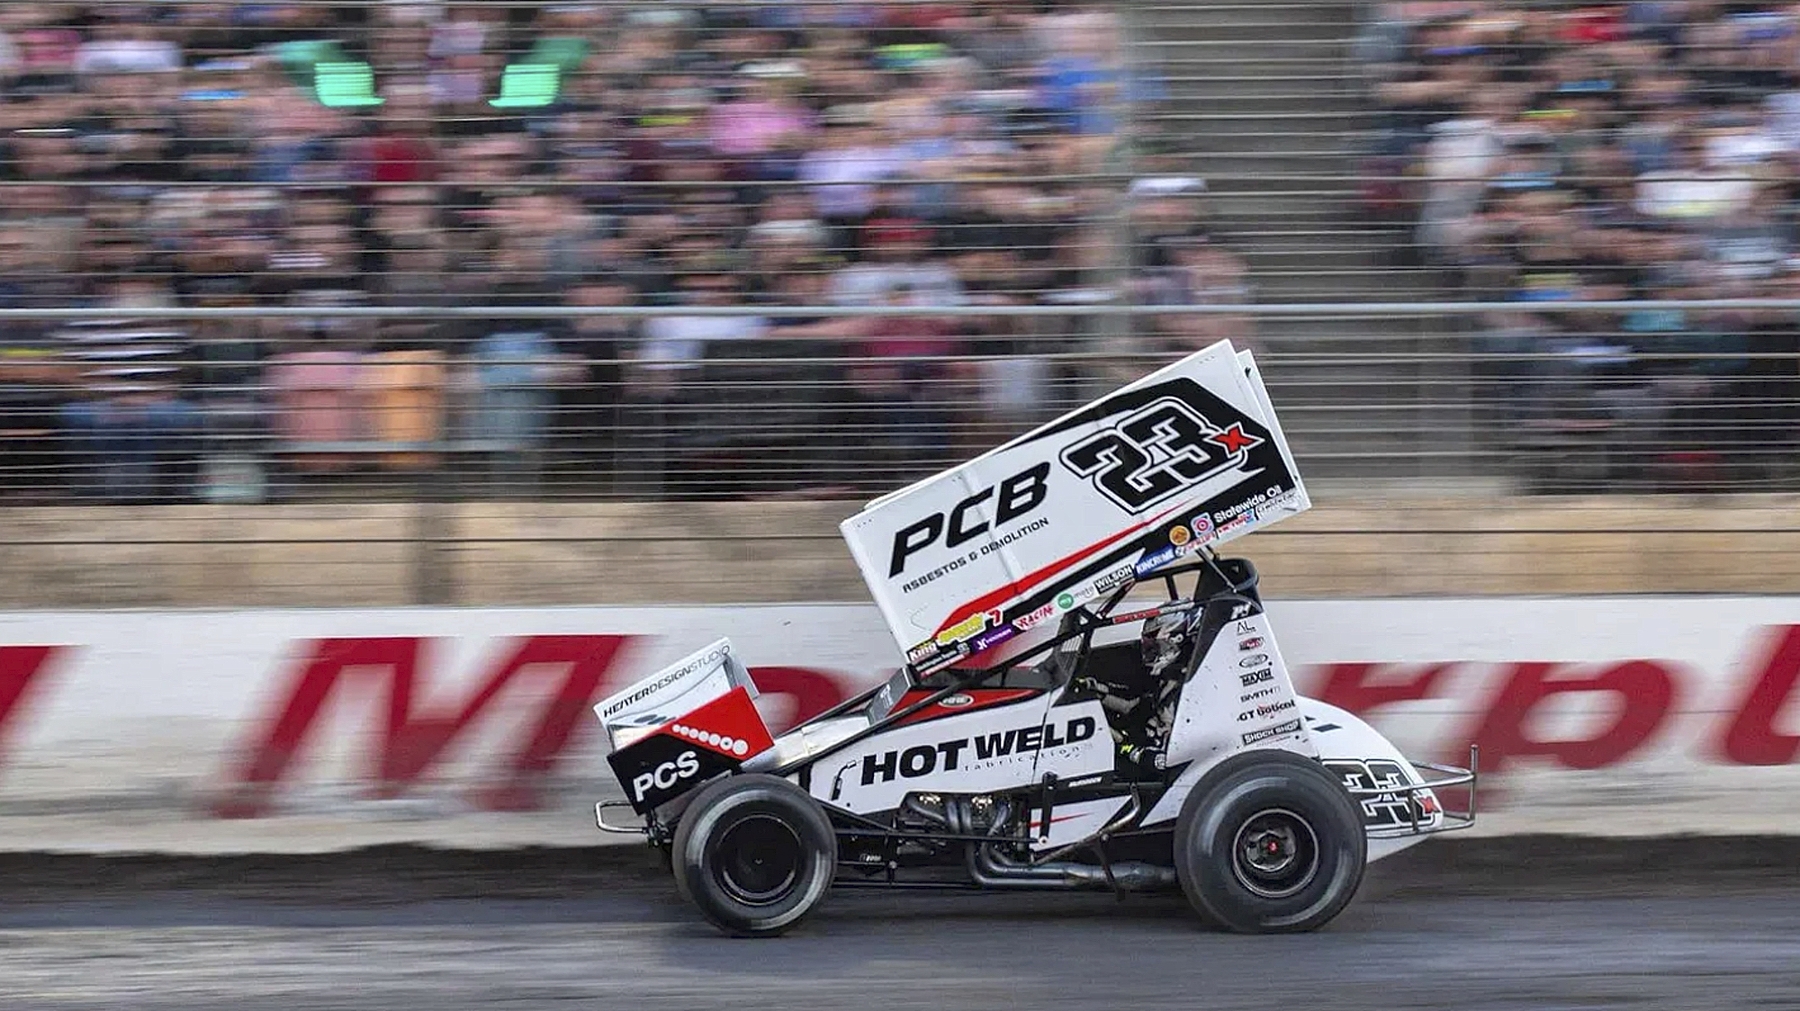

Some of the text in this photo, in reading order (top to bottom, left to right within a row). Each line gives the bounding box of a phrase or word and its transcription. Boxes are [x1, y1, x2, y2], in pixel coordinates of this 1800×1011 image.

[1214, 494, 1266, 523] Statewide
[1266, 484, 1282, 498] Oil
[888, 461, 1051, 579] PCB
[903, 557, 967, 593] ASBESTOS
[980, 517, 1049, 556] DEMOLITION
[1095, 565, 1132, 589] WILSON
[1242, 669, 1272, 684] MAXIM
[1239, 710, 1255, 721] GT
[1244, 729, 1276, 745] SHOCK
[1275, 722, 1299, 735] SHOP
[861, 716, 1096, 786] HOT WELD
[965, 746, 1079, 771] fabrication
[633, 751, 699, 802] PCS
